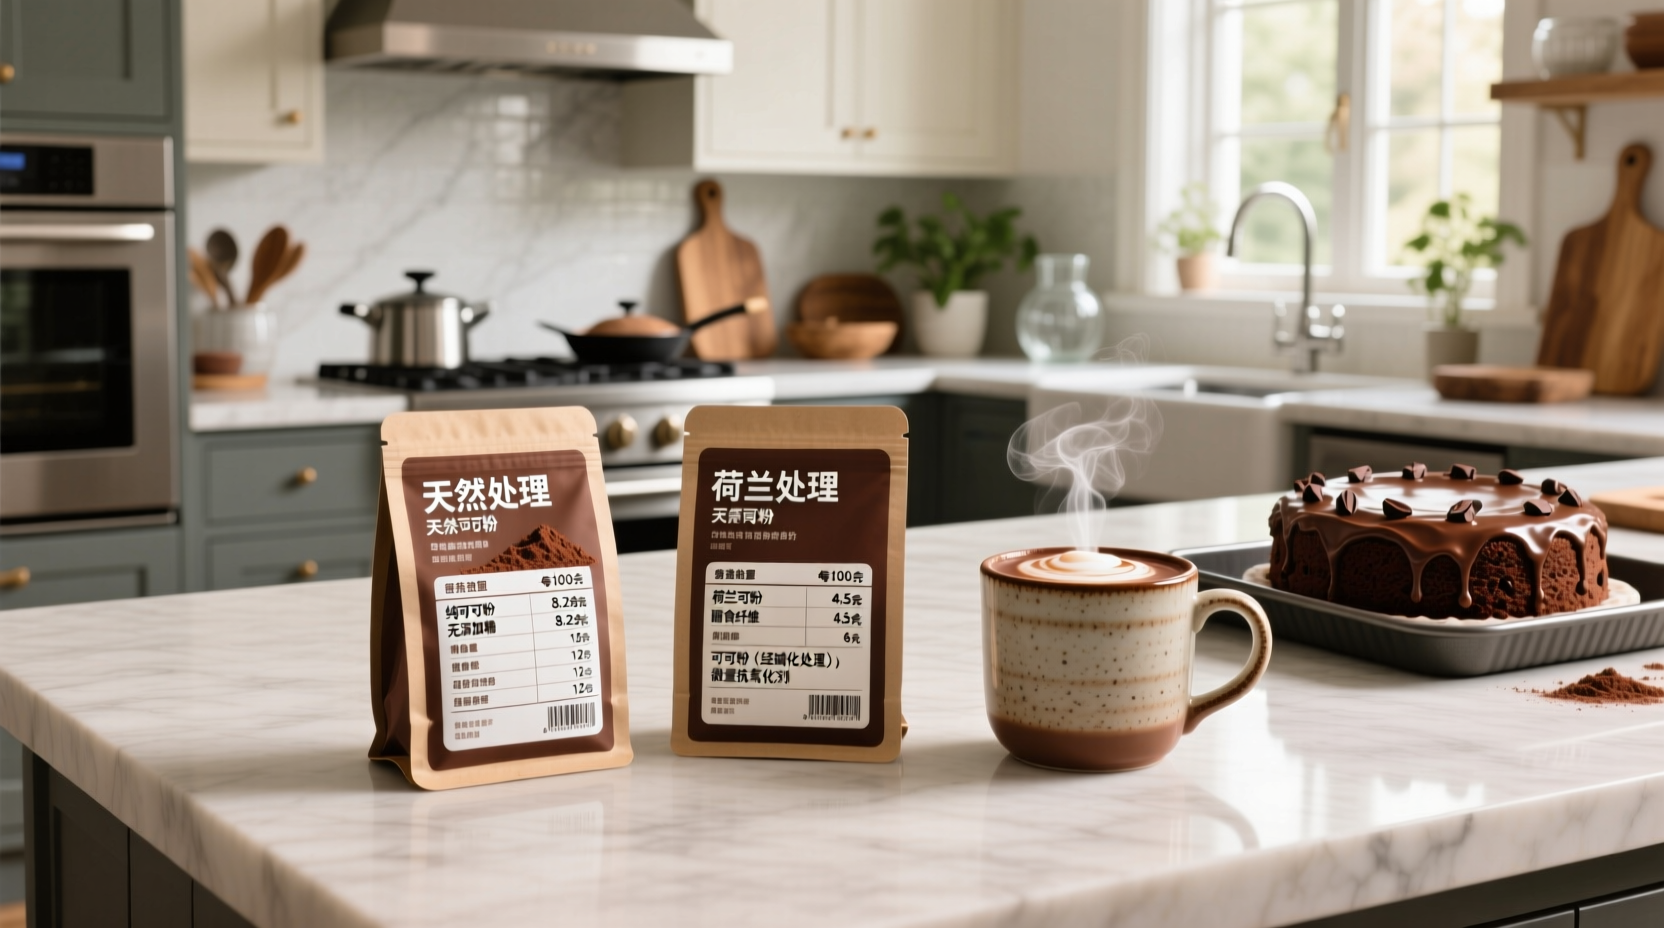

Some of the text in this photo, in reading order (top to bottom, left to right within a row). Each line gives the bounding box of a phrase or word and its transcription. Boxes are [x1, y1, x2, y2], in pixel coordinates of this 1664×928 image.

[423, 474, 552, 514] 天然处理
[711, 470, 839, 504] 荷兰处理
